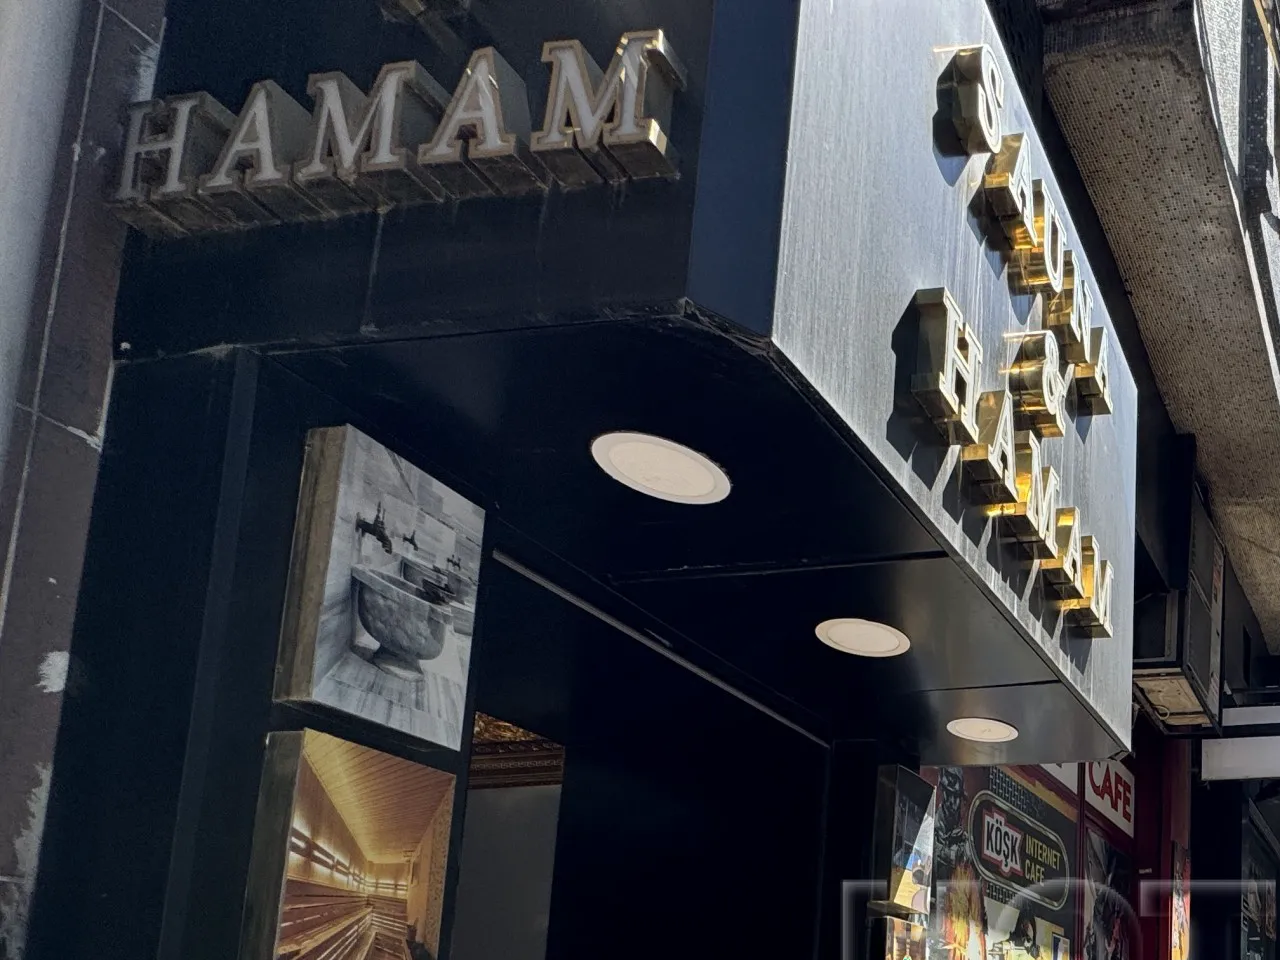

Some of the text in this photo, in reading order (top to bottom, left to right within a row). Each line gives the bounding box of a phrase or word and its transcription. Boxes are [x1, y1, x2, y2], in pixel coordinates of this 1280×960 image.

[116, 28, 672, 206] HAMAM
[962, 45, 1113, 414] SAUNA
[926, 288, 1113, 637] HAMAM
[986, 819, 1019, 867] KÖŞK
[1088, 762, 1132, 823] CAFE
[1025, 860, 1045, 887] CAFE
